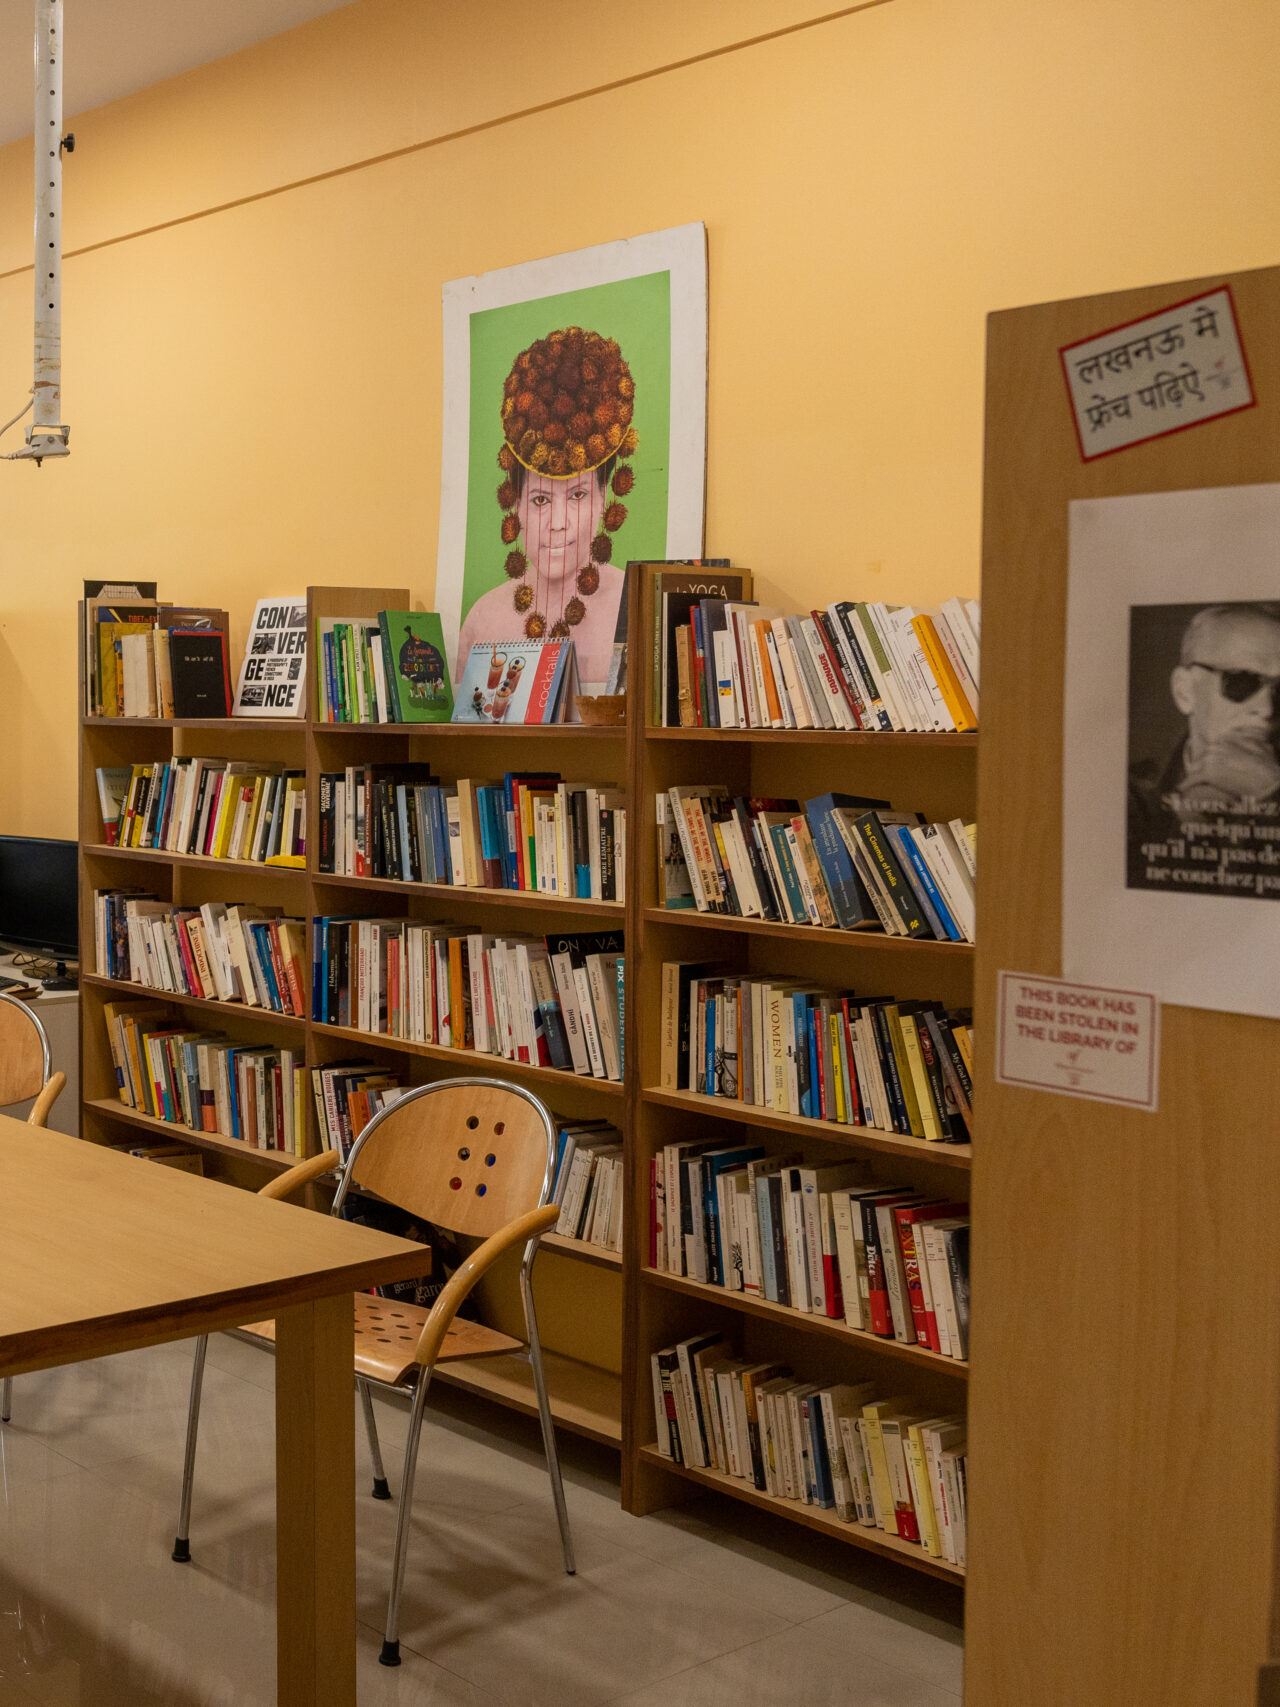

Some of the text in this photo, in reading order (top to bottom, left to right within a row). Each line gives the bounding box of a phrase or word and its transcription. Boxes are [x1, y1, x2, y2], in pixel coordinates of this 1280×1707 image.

[689, 584, 727, 599] YOGA
[128, 615, 144, 623] TIBET
[256, 606, 289, 629] CON
[277, 632, 307, 654] VER
[244, 658, 266, 680] GE
[538, 649, 561, 708] cocktails
[818, 653, 839, 695] CARNAGE
[265, 684, 297, 707] NCE
[863, 822, 898, 886] The Cinemas of India
[600, 861, 608, 884] PIERRE
[558, 940, 580, 953] ON
[595, 936, 619, 949] VA
[1021, 986, 1136, 1016] THIS BOOK HAS
[566, 1008, 578, 1035] GANDHI
[771, 1000, 782, 1058] WOMEN
[1015, 1004, 1139, 1036] BEEN STOLEN IN
[1017, 1023, 1137, 1054] THE LIBRARY OF
[900, 1224, 922, 1291] EXTRAS
